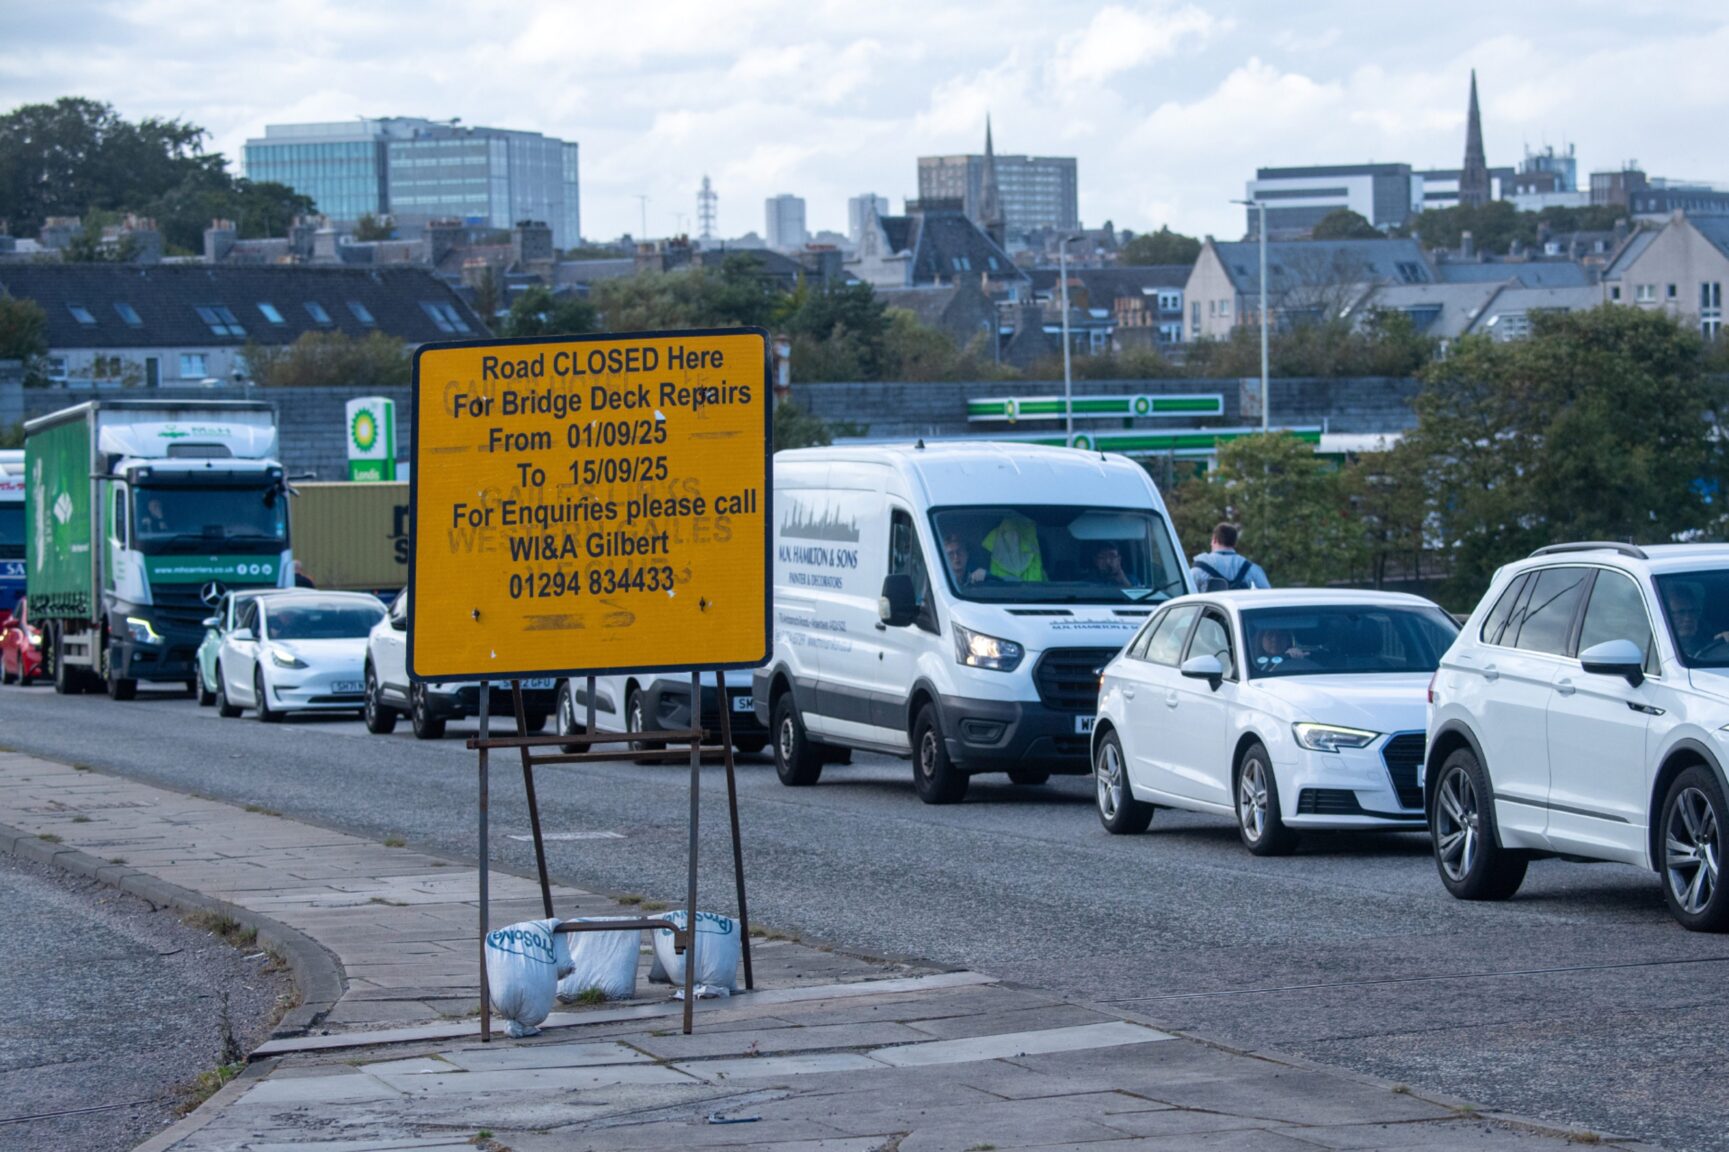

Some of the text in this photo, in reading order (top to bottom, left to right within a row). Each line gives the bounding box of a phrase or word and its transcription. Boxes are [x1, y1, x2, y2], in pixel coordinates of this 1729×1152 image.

[482, 346, 723, 380] Road CLOSED Here
[454, 394, 494, 418] For
[502, 389, 582, 419] Bridge
[591, 384, 651, 410] Deck
[659, 380, 751, 412] Repairs
[489, 419, 667, 453] From 01/09/25
[517, 456, 668, 488] To 15/09/25
[453, 488, 756, 530] For Enquiries please call
[509, 530, 669, 562] WI&A Gilbert
[793, 546, 829, 566] HAMILTON
[836, 549, 858, 569] SONS
[510, 571, 580, 600] 01294
[589, 566, 674, 595] 834433
